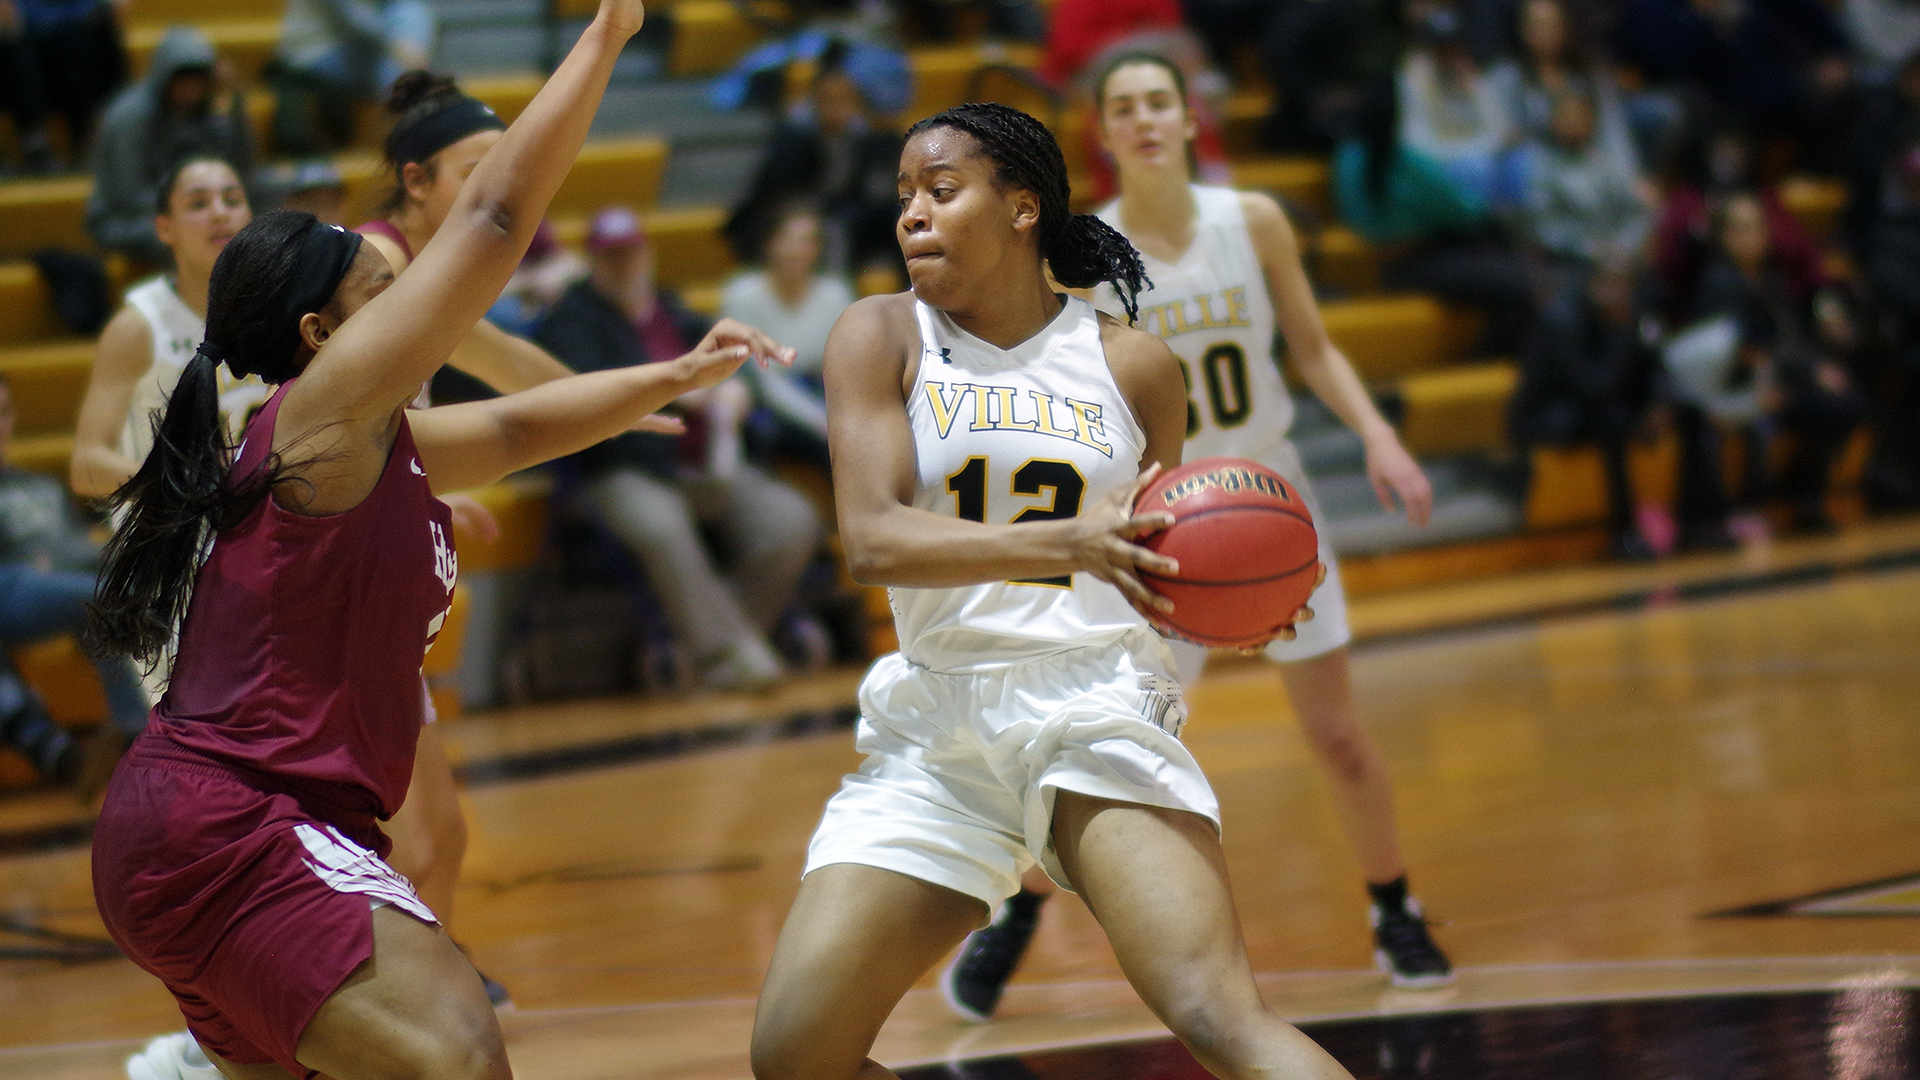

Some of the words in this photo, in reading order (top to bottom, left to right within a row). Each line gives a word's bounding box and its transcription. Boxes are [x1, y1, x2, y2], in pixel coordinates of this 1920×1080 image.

[925, 381, 1113, 459] VILLE
[1174, 340, 1255, 440] 0
[945, 455, 1088, 591] 12
